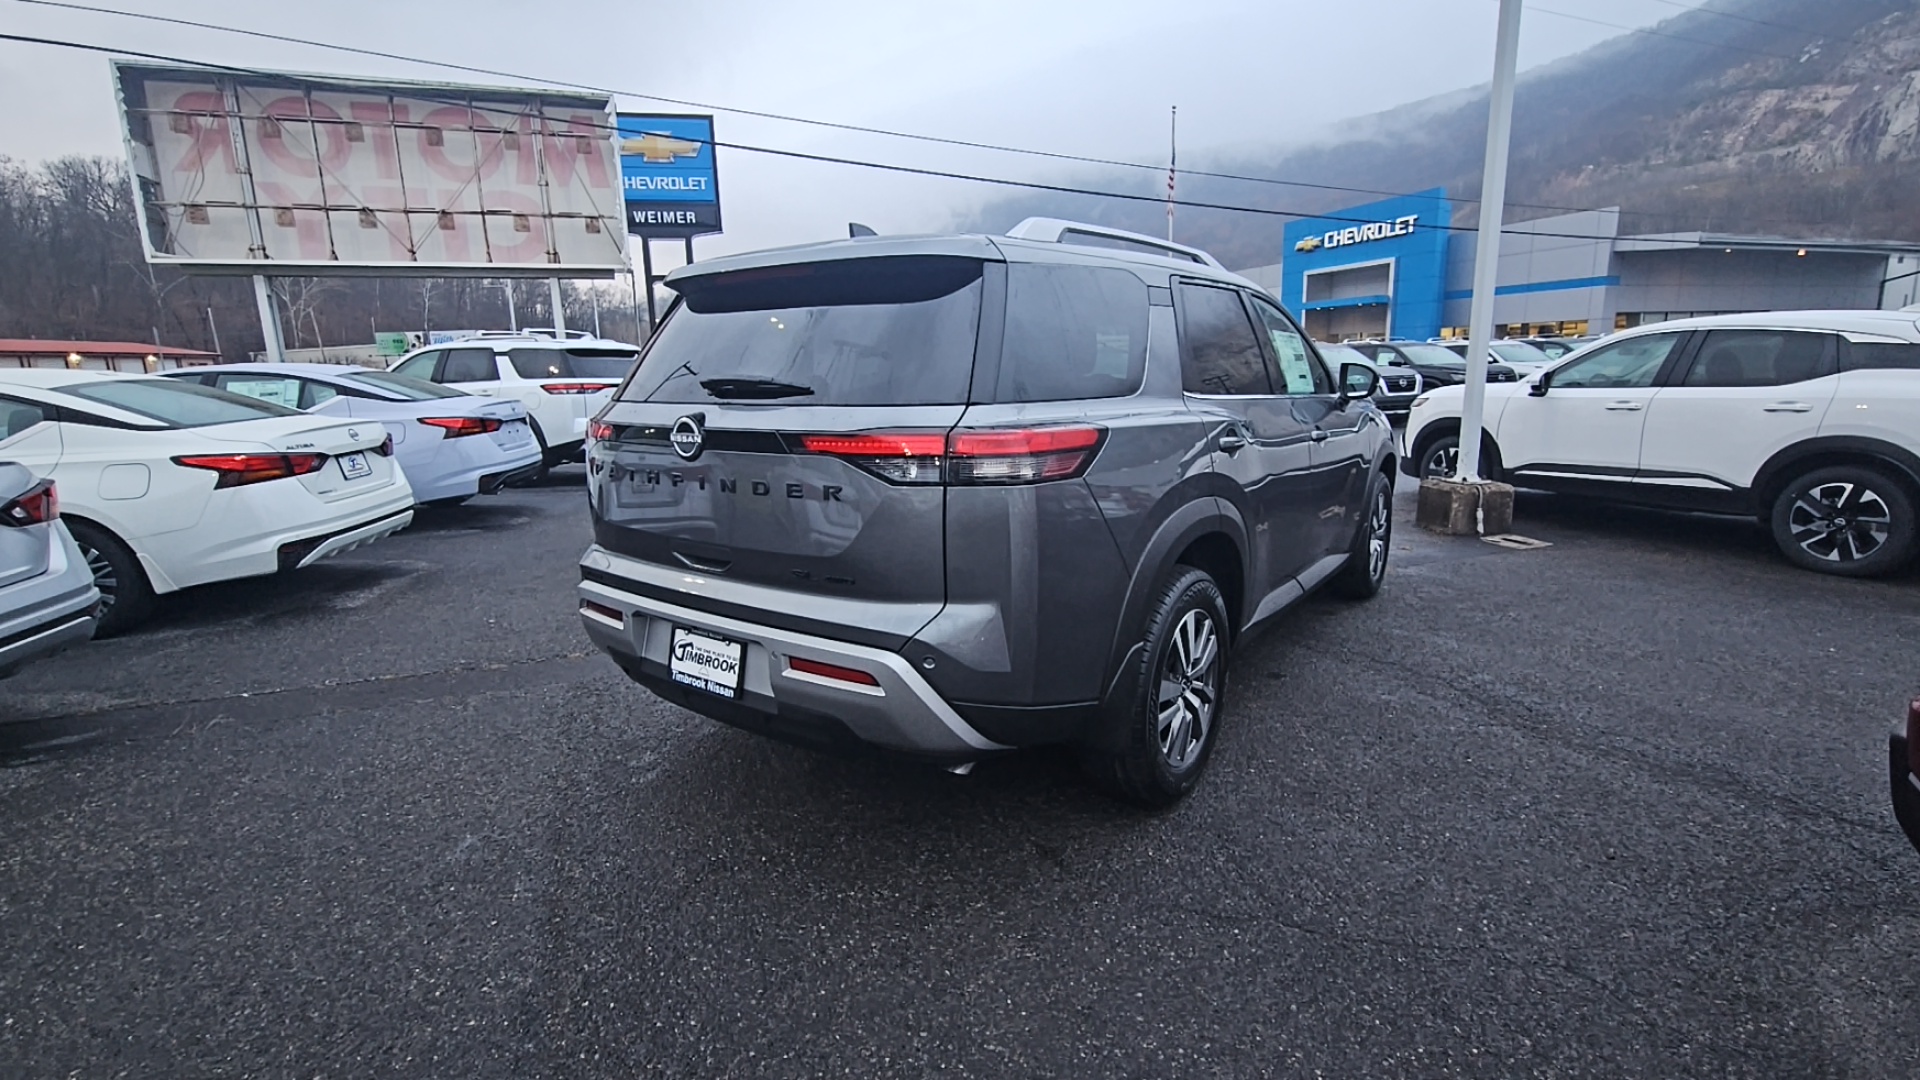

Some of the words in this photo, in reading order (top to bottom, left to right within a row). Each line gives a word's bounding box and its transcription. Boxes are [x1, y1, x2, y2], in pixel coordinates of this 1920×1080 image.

[622, 176, 708, 190] HEVROLET
[632, 210, 697, 224] WEIMER
[1323, 214, 1418, 249] CHEVROLET
[670, 432, 701, 444] NISSAN
[593, 458, 843, 501] PATHFINDER
[673, 639, 738, 675] TIMBROOK
[672, 669, 706, 690] Timbrook
[706, 680, 735, 698] Nissan
